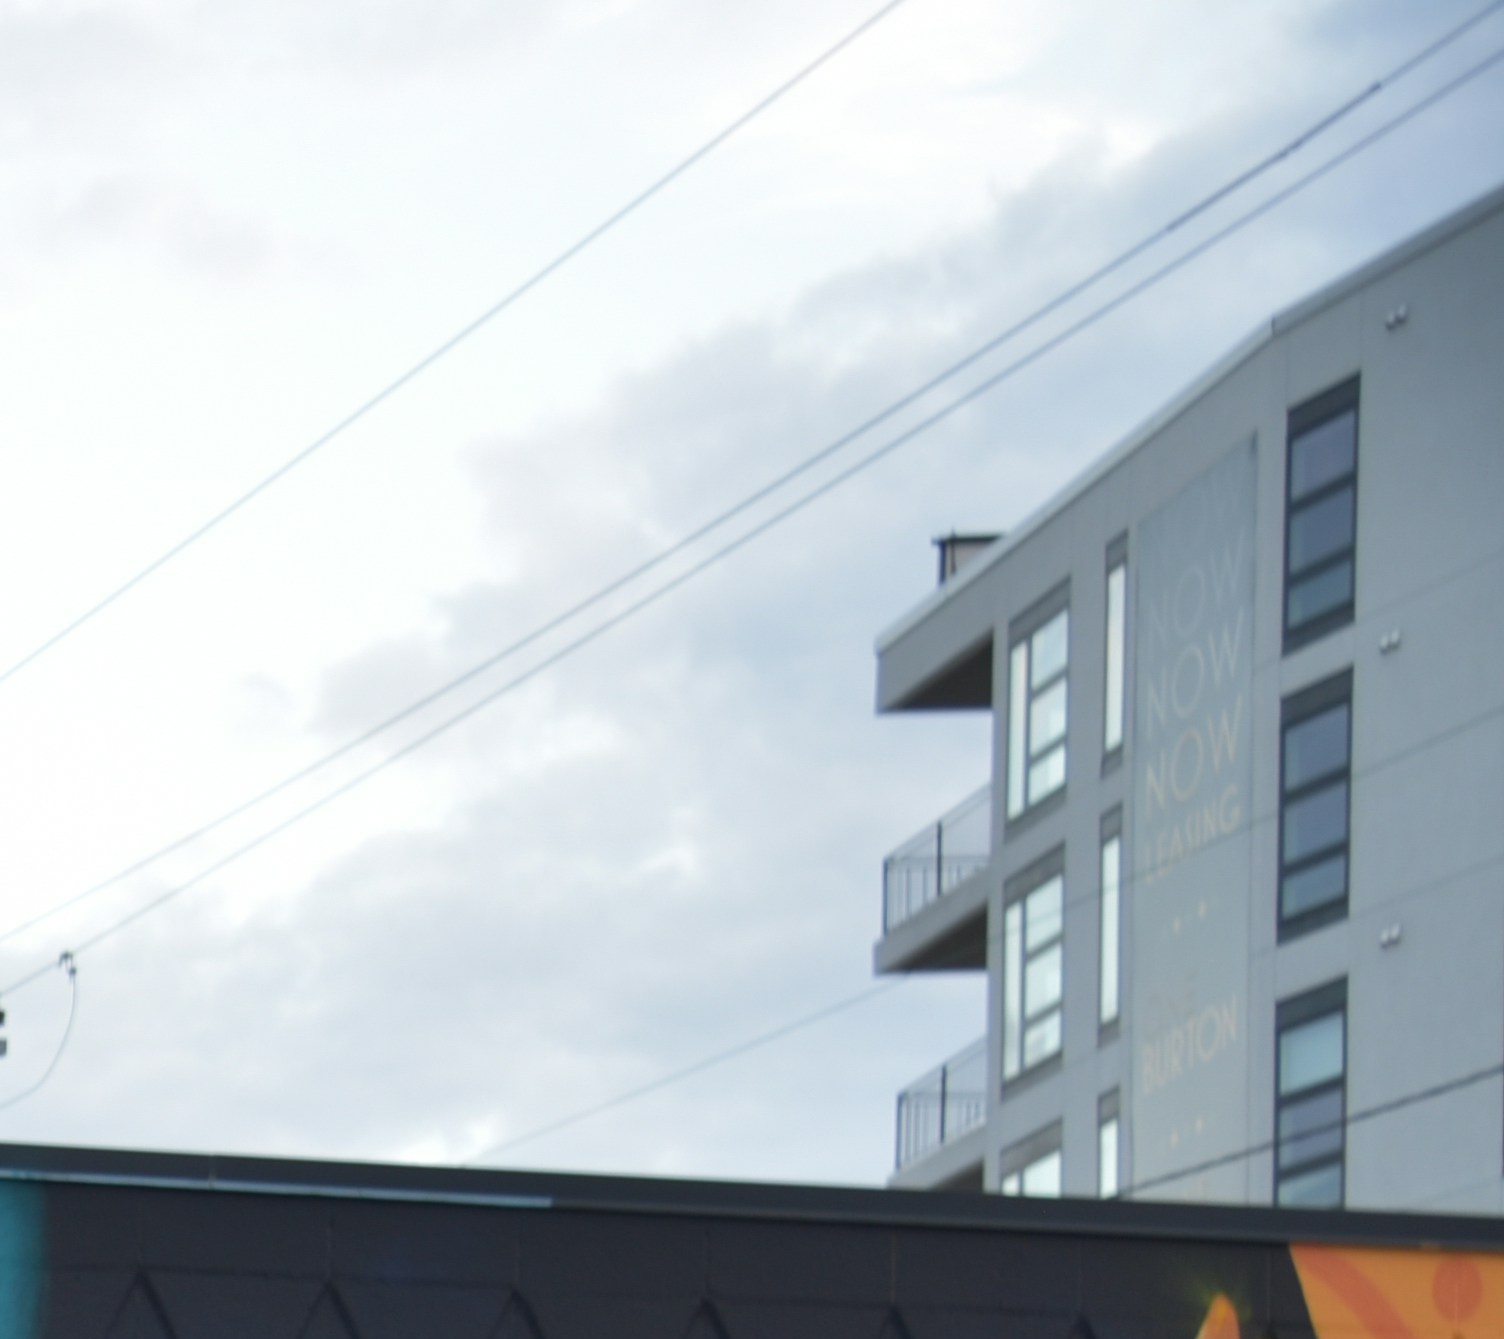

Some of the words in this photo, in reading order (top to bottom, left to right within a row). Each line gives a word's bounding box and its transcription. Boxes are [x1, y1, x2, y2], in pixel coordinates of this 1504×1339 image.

[1148, 526, 1245, 658] NOW
[1147, 606, 1244, 742] NOW
[1145, 693, 1244, 821] NOW
[1143, 782, 1243, 884] LEASING
[1141, 992, 1239, 1096] BURTON
